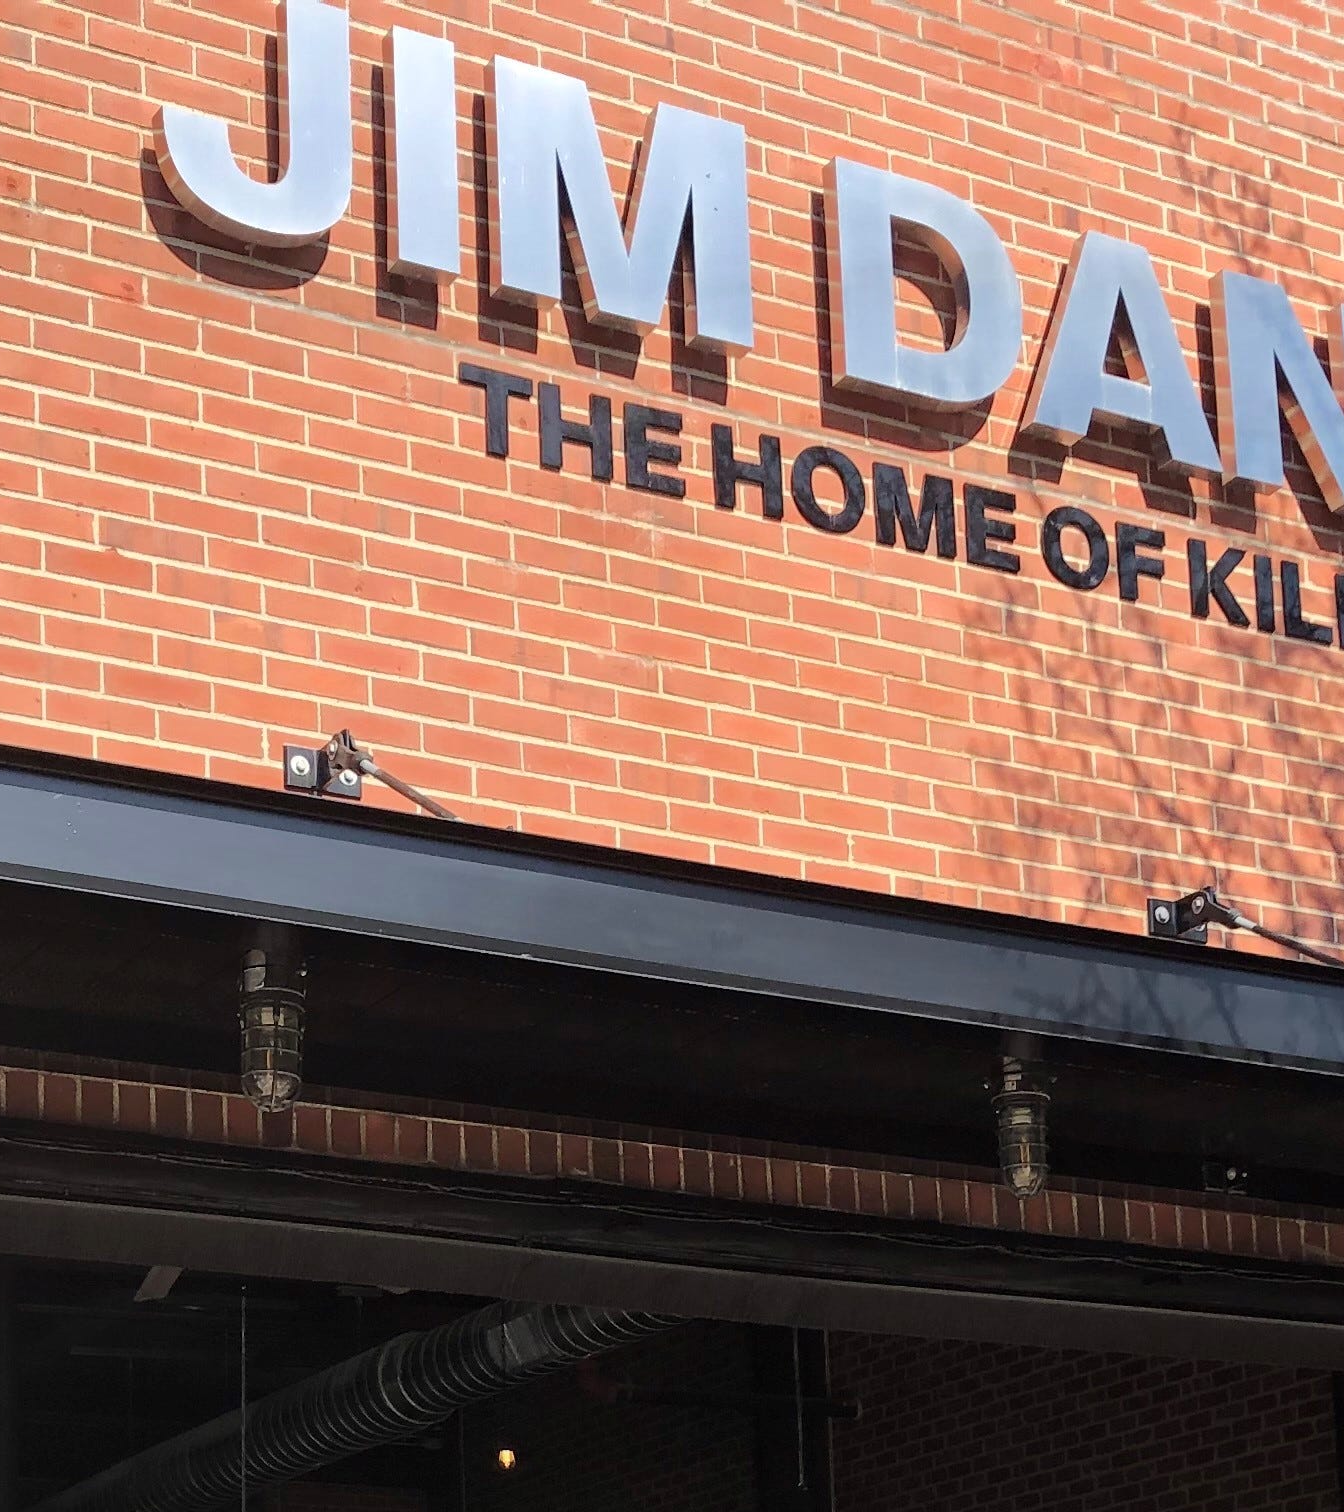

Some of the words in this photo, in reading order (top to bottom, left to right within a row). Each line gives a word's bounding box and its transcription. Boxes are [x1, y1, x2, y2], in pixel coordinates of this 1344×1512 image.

[154, 0, 754, 357] JIM
[459, 362, 686, 498] THE
[712, 423, 1022, 574] HOME
[1040, 505, 1166, 601] OF
